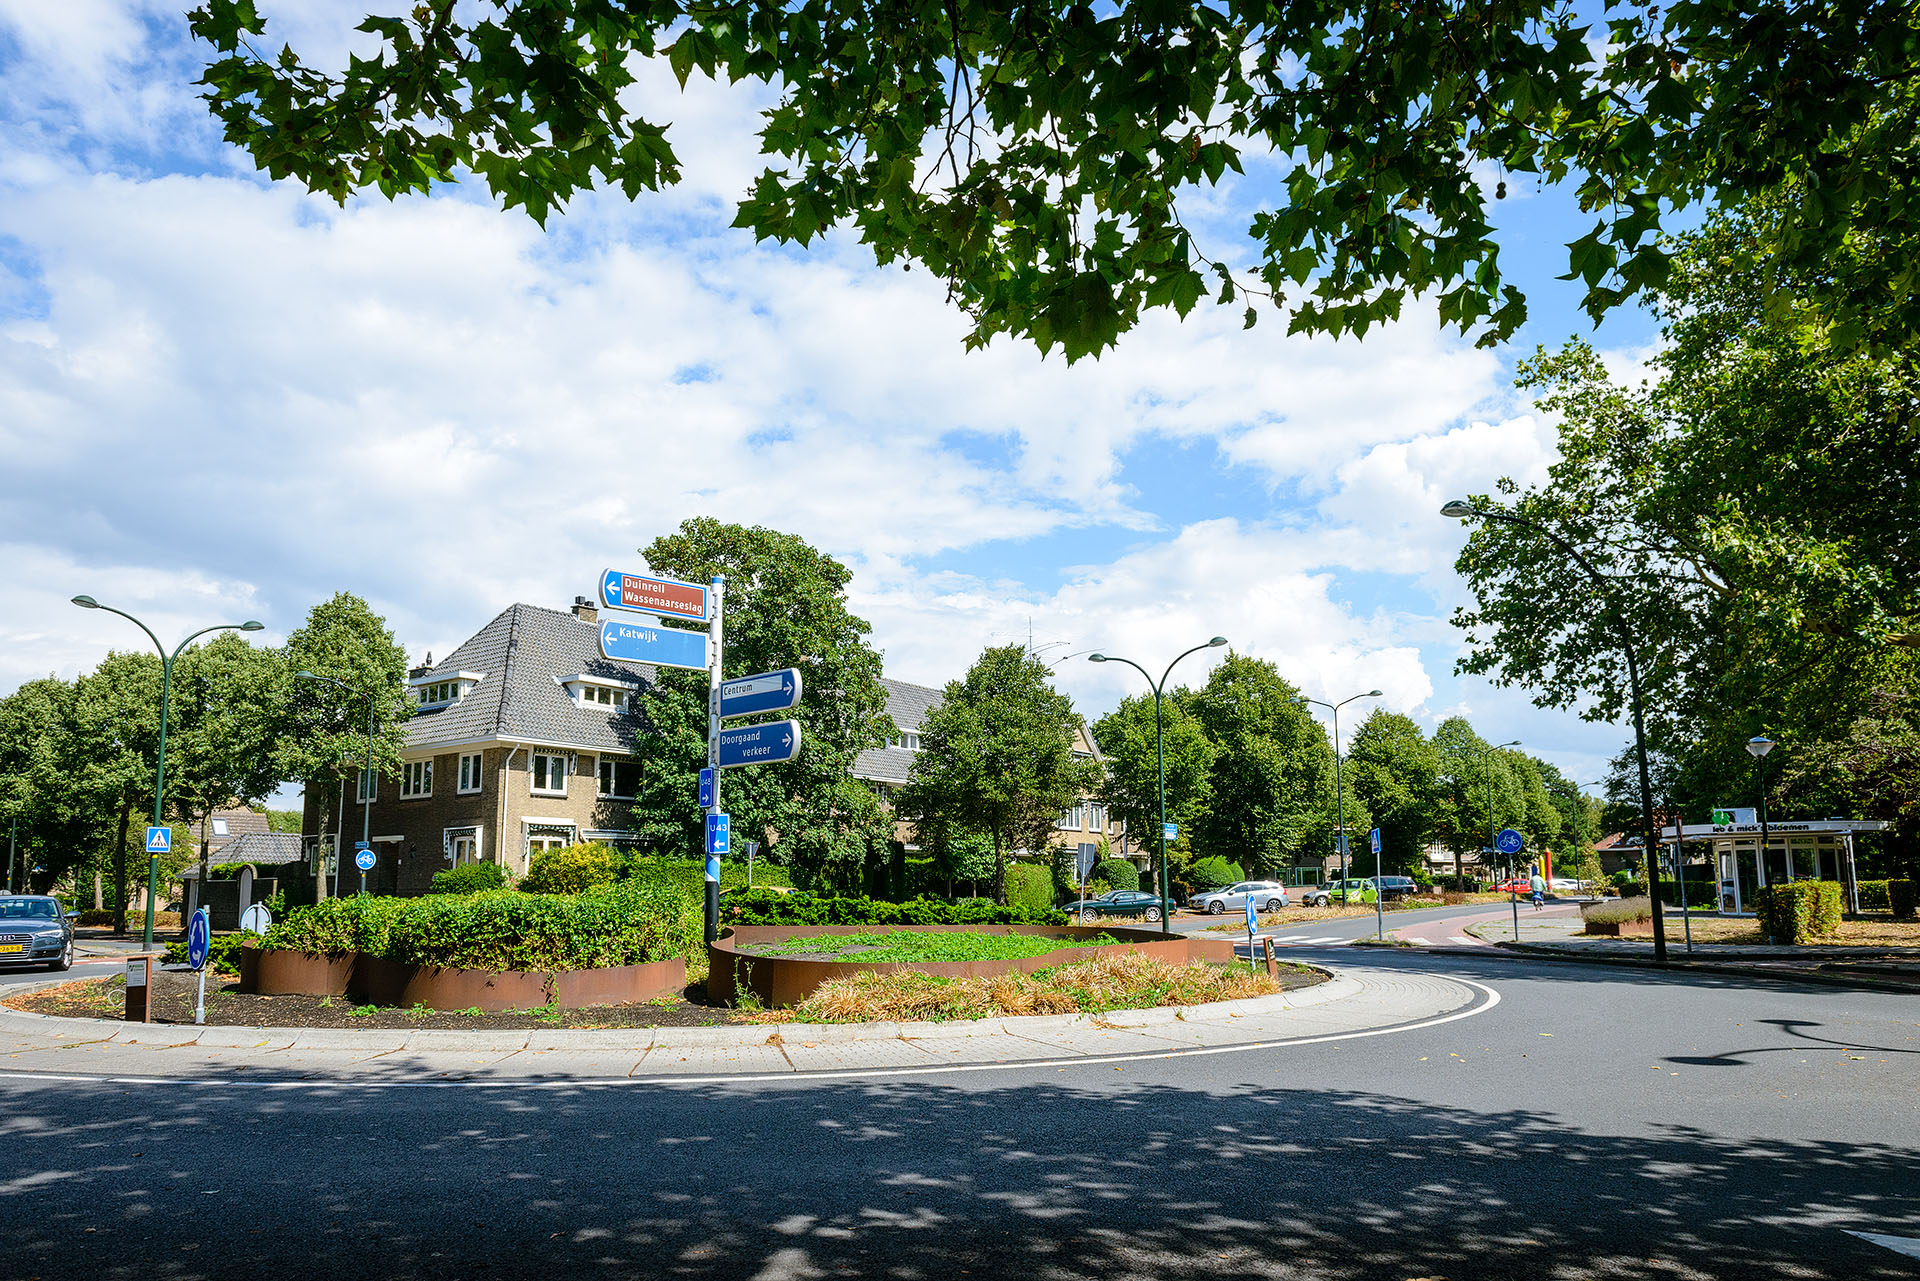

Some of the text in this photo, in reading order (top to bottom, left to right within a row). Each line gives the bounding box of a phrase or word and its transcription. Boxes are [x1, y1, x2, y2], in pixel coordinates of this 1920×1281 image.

[624, 578, 665, 593] Duinrell
[624, 591, 703, 614] Wassenaarseslag
[619, 627, 657, 643] Katwijk
[723, 684, 753, 696] Centrum
[721, 730, 761, 745] Doorgaand
[742, 746, 771, 757] verkeer
[710, 823, 728, 832] U43
[1727, 825, 1734, 833] &
[1768, 824, 1809, 832] bloemen
